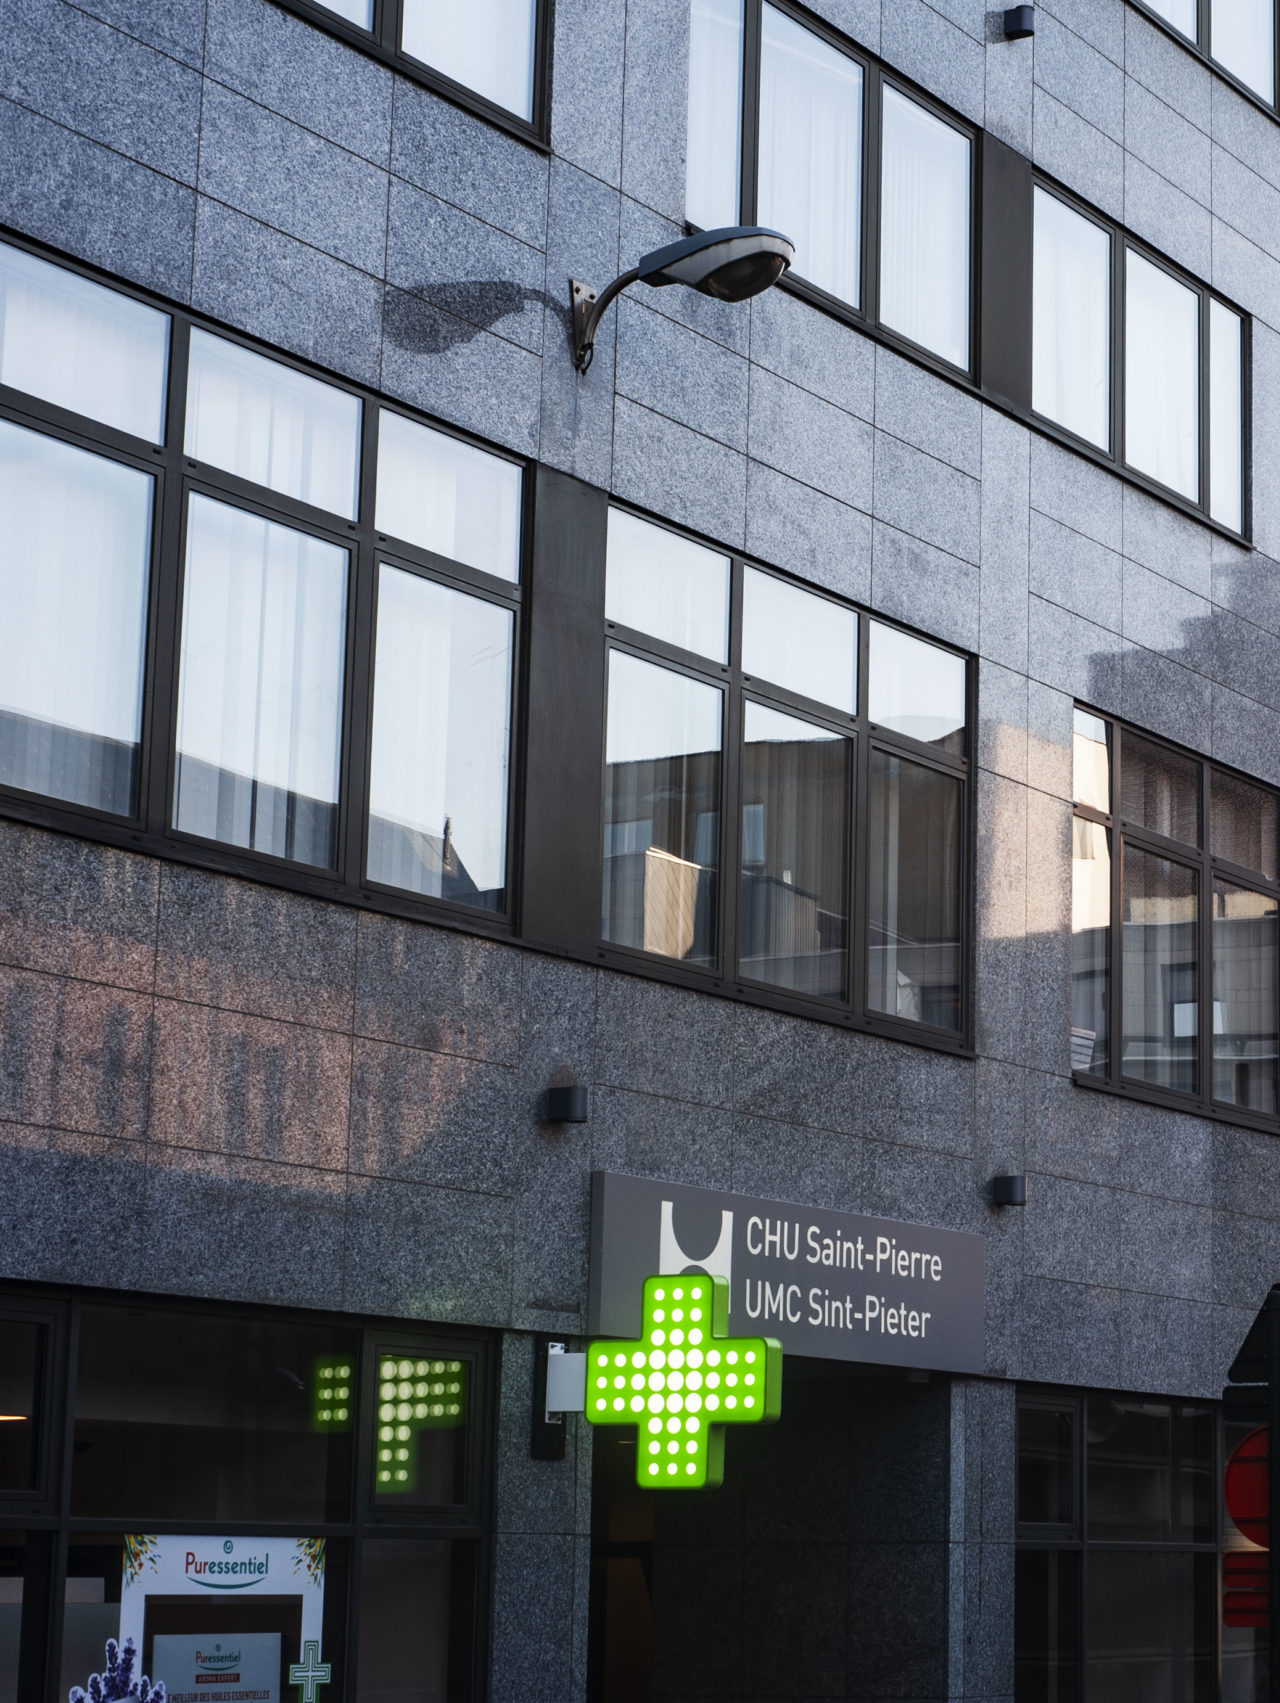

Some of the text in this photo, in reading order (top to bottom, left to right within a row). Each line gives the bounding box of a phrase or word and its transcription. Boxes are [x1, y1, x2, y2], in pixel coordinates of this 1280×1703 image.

[746, 1215, 943, 1282] CHU Saint-Pierre
[745, 1278, 931, 1338] UMC Sint-Pieter
[185, 1552, 269, 1574] Puressentiel
[195, 1651, 241, 1664] Puressentiel
[172, 1692, 198, 1703] MEILLEUR
[199, 1692, 210, 1702] DES
[232, 1690, 270, 1701] ESSENTIELLES
